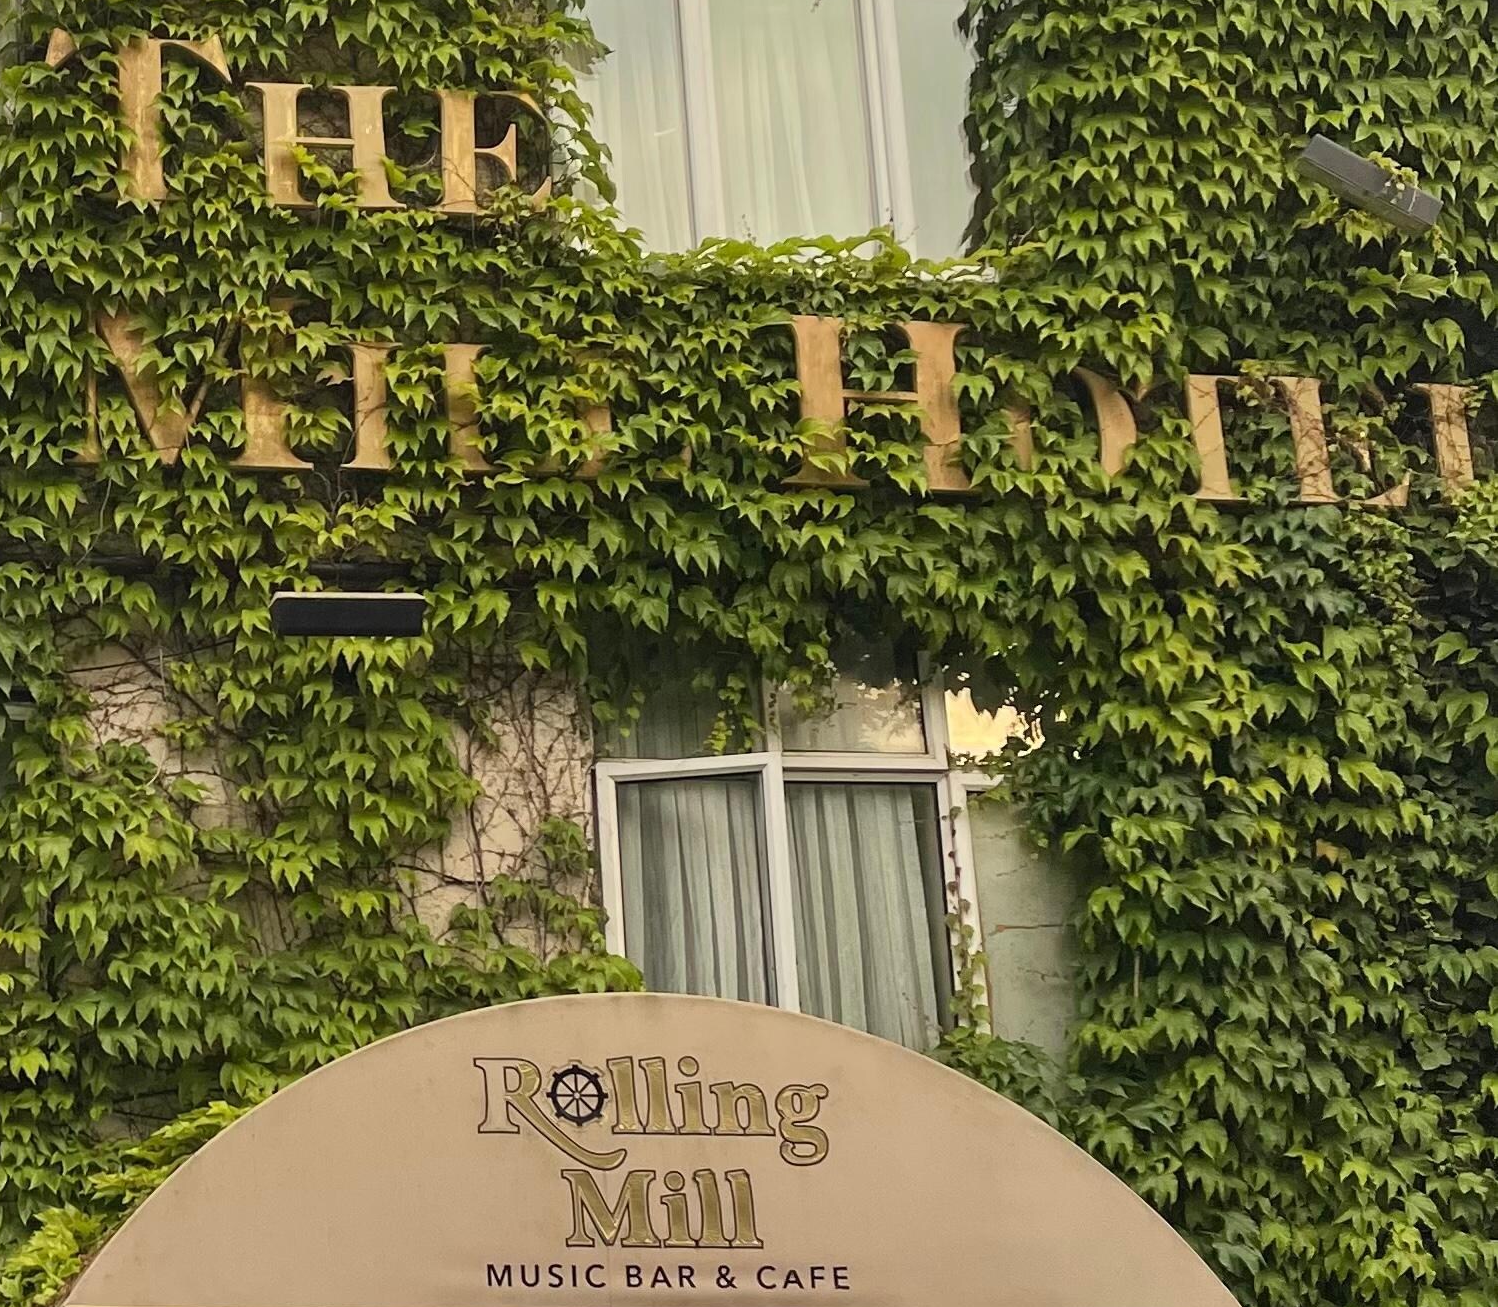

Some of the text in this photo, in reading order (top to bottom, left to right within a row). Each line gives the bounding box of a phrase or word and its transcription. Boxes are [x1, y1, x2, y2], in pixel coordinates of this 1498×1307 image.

[46, 27, 552, 215] THE
[473, 1056, 830, 1170] Rolling
[561, 1169, 764, 1249] Mill
[486, 1264, 851, 1290] MUSIC BAR & CAFE
